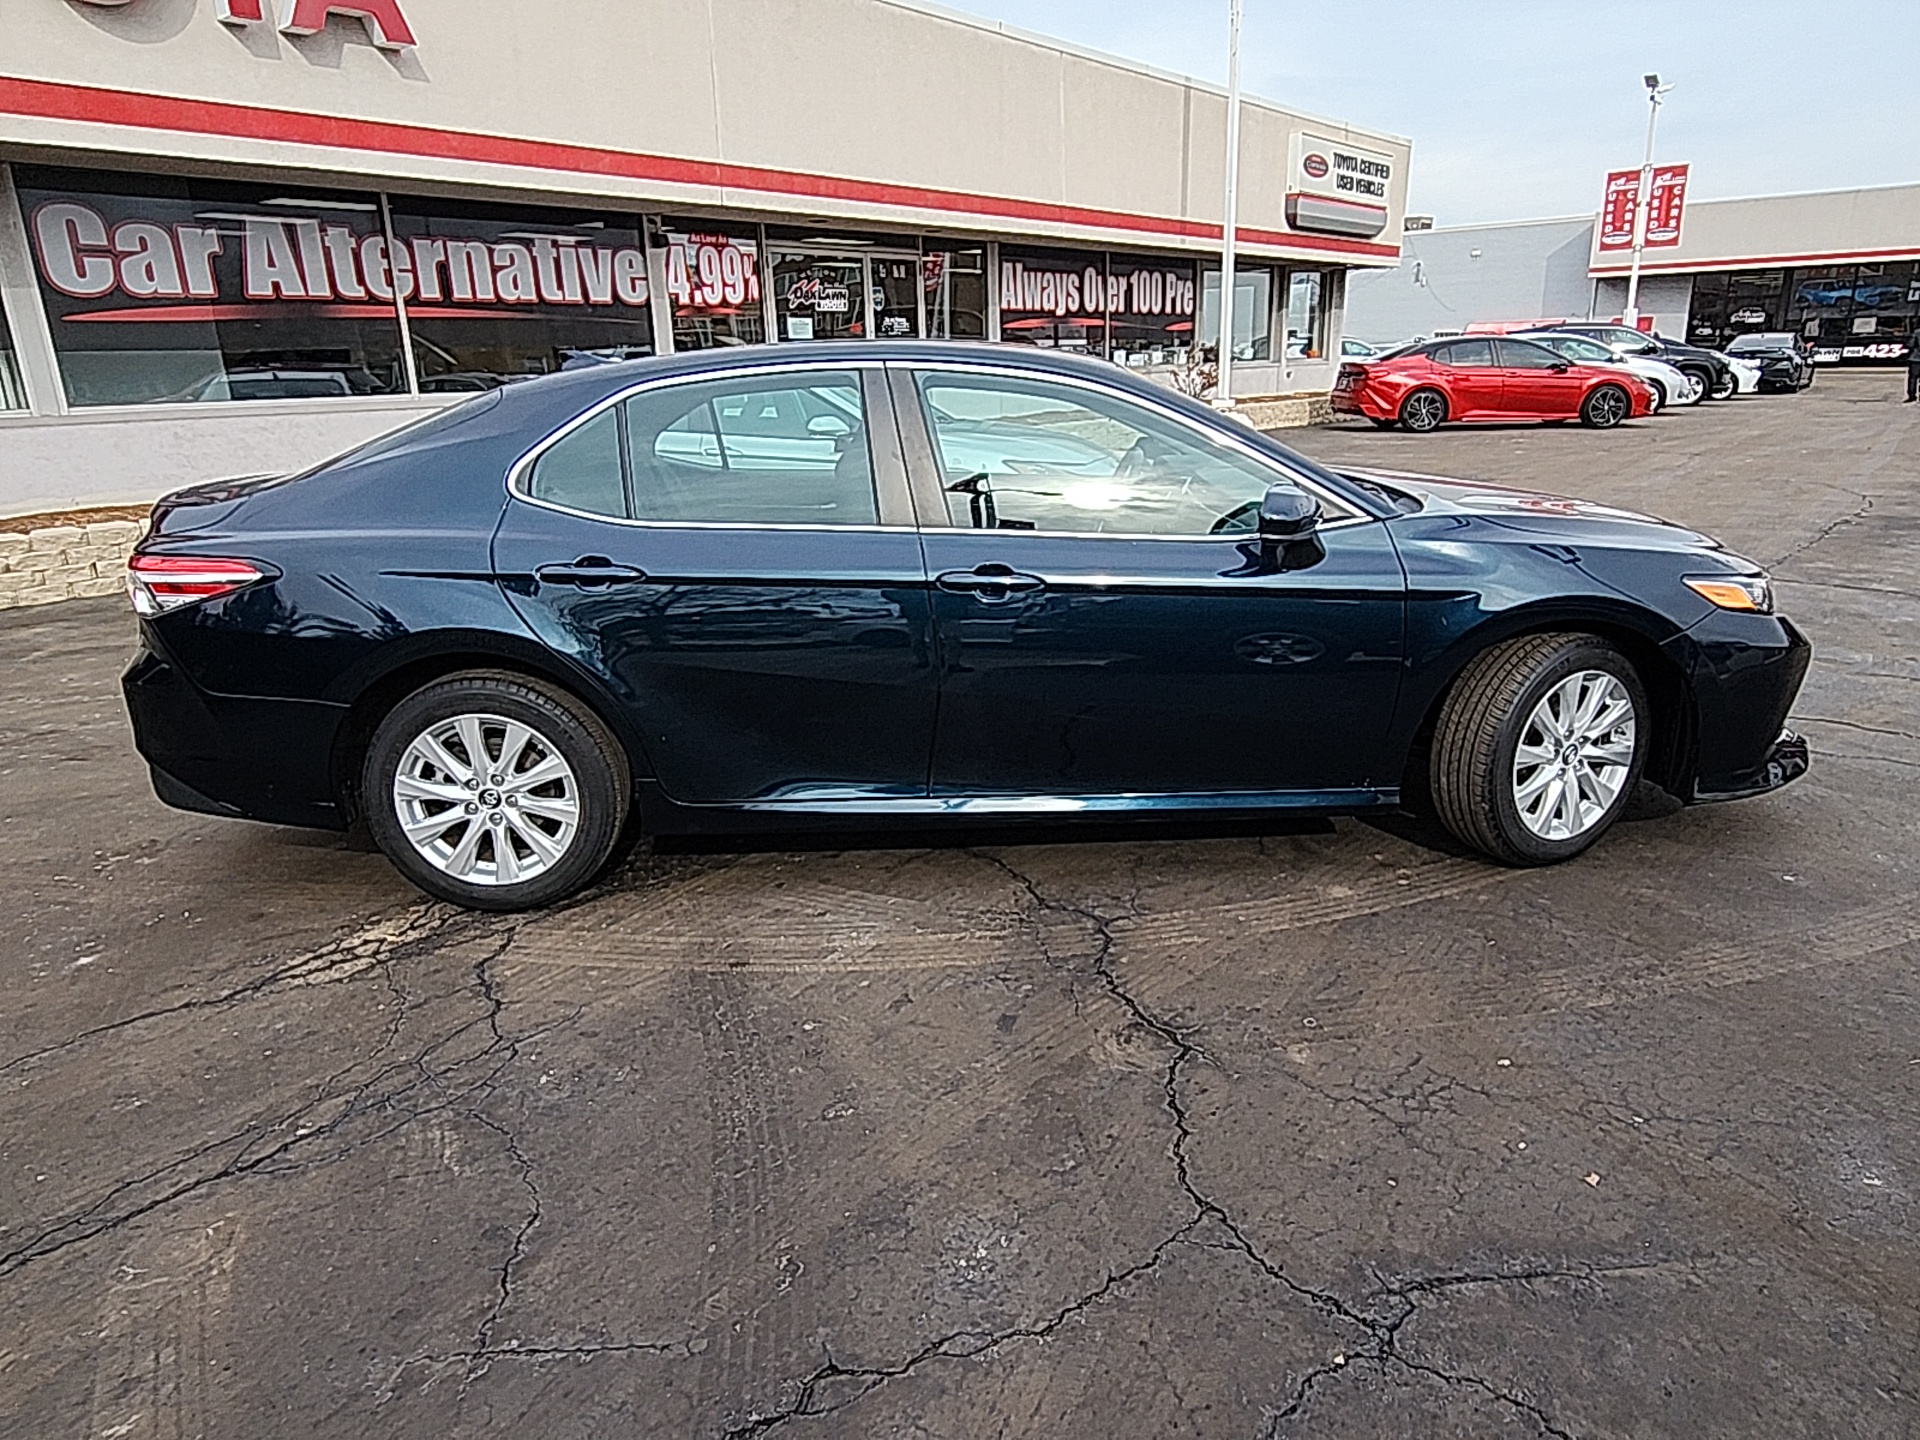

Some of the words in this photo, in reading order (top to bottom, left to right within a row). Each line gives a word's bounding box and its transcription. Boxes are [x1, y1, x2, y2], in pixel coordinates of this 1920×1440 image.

[1333, 152, 1358, 173] TOYOTA
[1336, 172, 1355, 191] USED
[1604, 193, 1617, 233] USED
[1649, 188, 1662, 229] USED
[1669, 186, 1682, 228] CARS
[33, 201, 223, 298] Car
[242, 216, 650, 304] Alternative
[667, 244, 759, 306] 4.99%
[1001, 261, 1080, 316] Always
[1083, 266, 1128, 313] Over
[1129, 269, 1163, 315] 100
[1164, 272, 1194, 315] Pre
